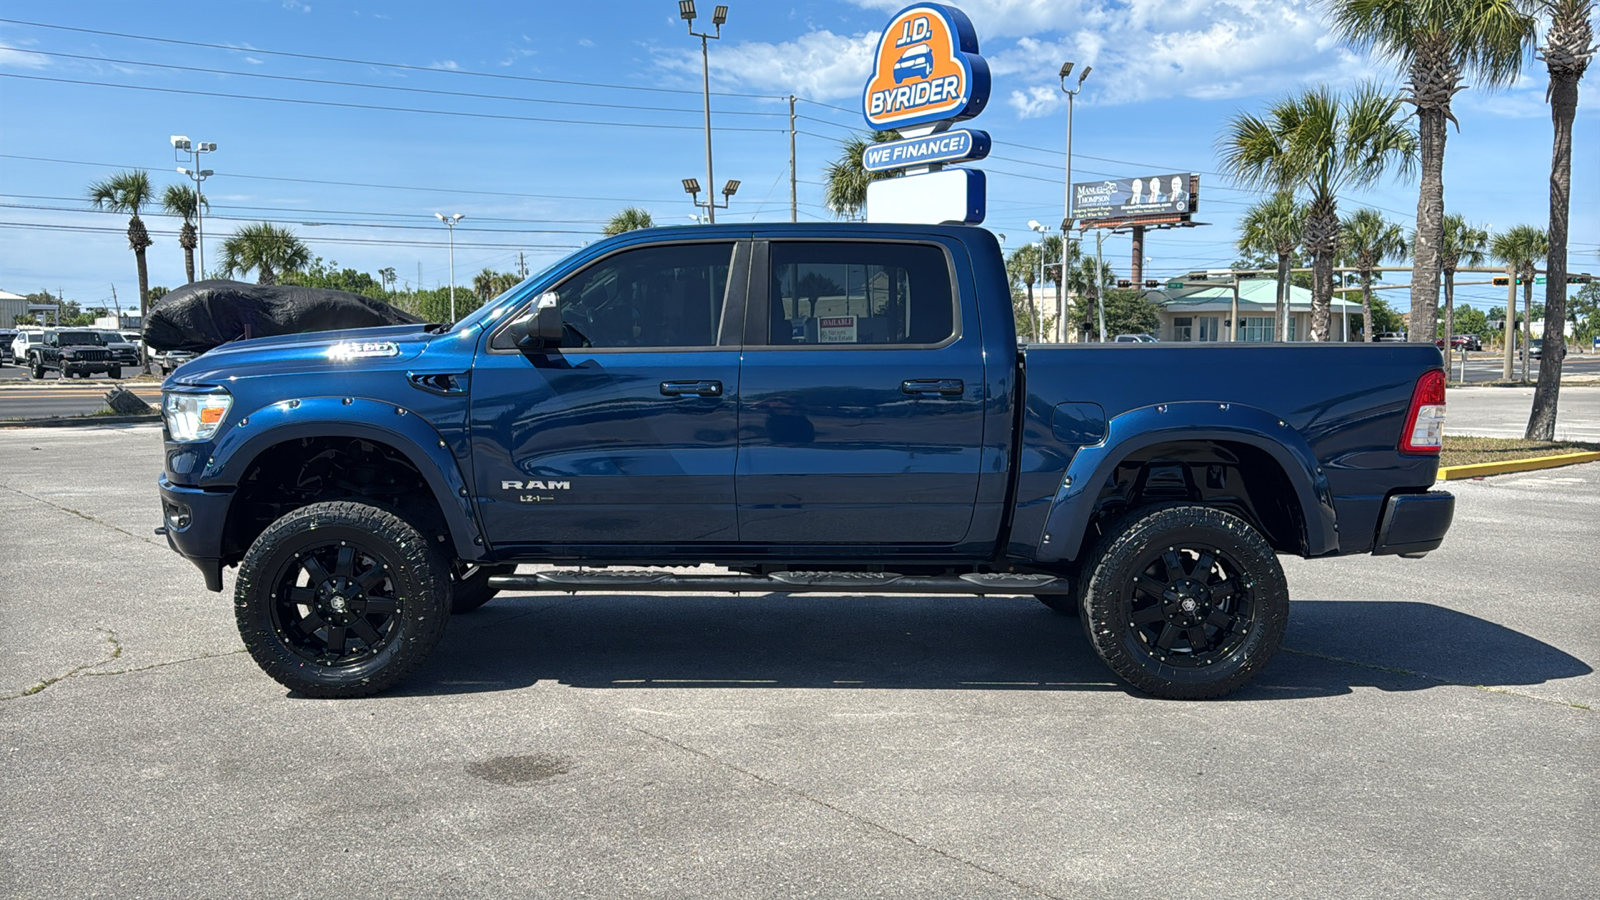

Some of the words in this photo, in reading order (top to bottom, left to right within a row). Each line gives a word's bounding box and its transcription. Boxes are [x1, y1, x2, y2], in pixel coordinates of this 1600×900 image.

[896, 17, 932, 47] J.D.
[868, 149, 890, 165] WE
[892, 136, 966, 161] FINANCE!
[822, 318, 853, 326] AVAILABLE
[501, 480, 570, 490] RAM
